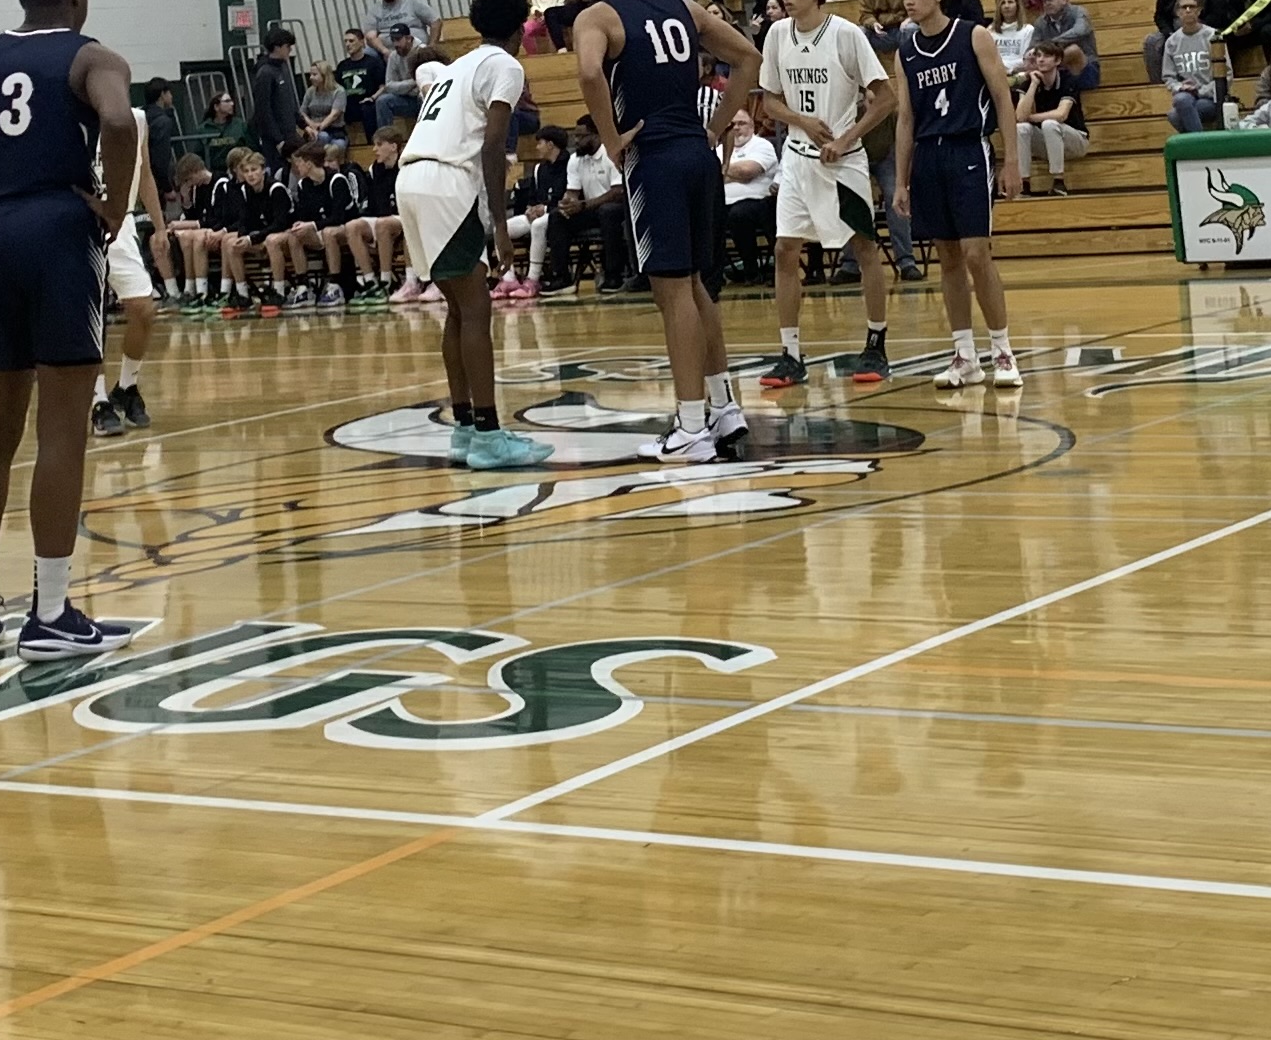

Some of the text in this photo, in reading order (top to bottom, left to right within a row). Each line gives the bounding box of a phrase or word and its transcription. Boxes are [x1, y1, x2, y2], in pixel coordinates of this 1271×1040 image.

[645, 18, 691, 64] 10
[1174, 51, 1210, 73] SHS
[786, 68, 828, 85] VIKINGS
[916, 62, 957, 89] PERRY
[799, 90, 815, 113] 15
[934, 87, 950, 117] 4
